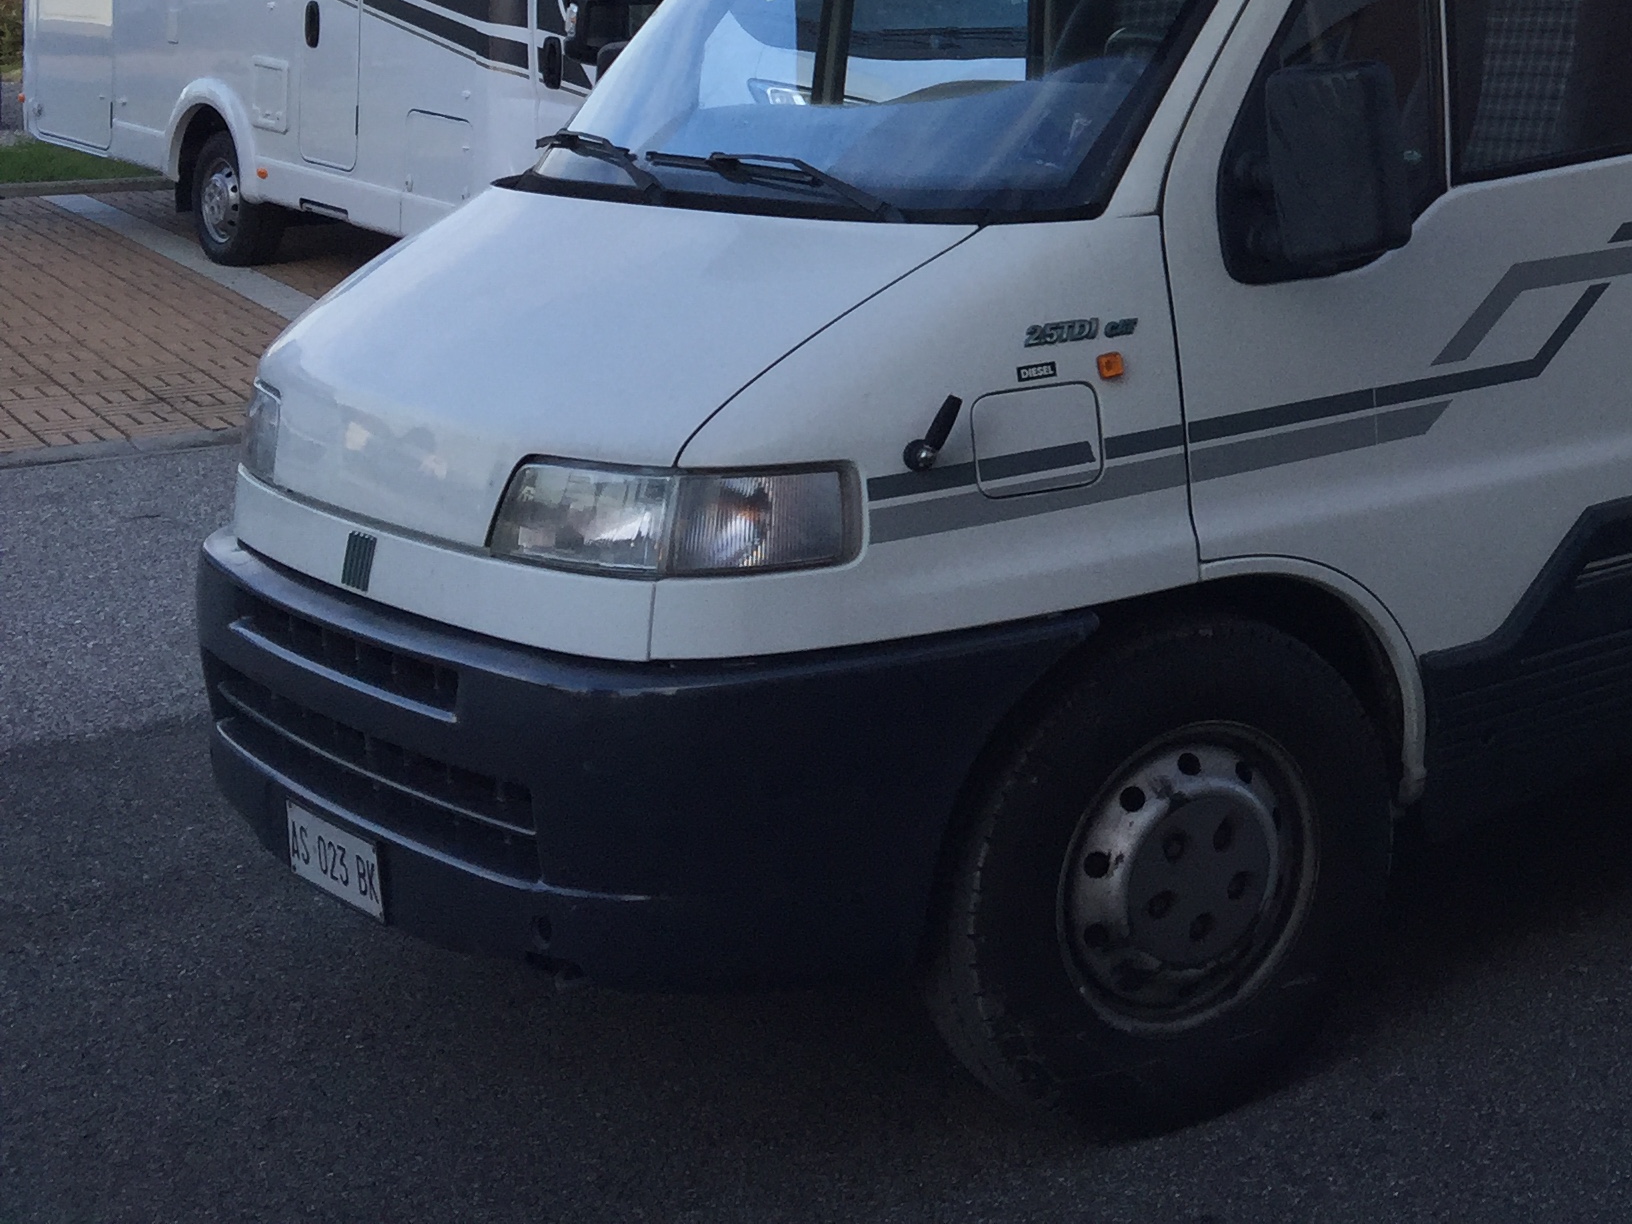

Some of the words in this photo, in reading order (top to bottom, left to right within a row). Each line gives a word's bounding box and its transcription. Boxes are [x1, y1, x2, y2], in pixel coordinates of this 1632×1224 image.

[1020, 365, 1055, 379] DIESEL
[291, 820, 310, 866] AS
[317, 834, 349, 888] 023
[355, 854, 380, 905] BK
